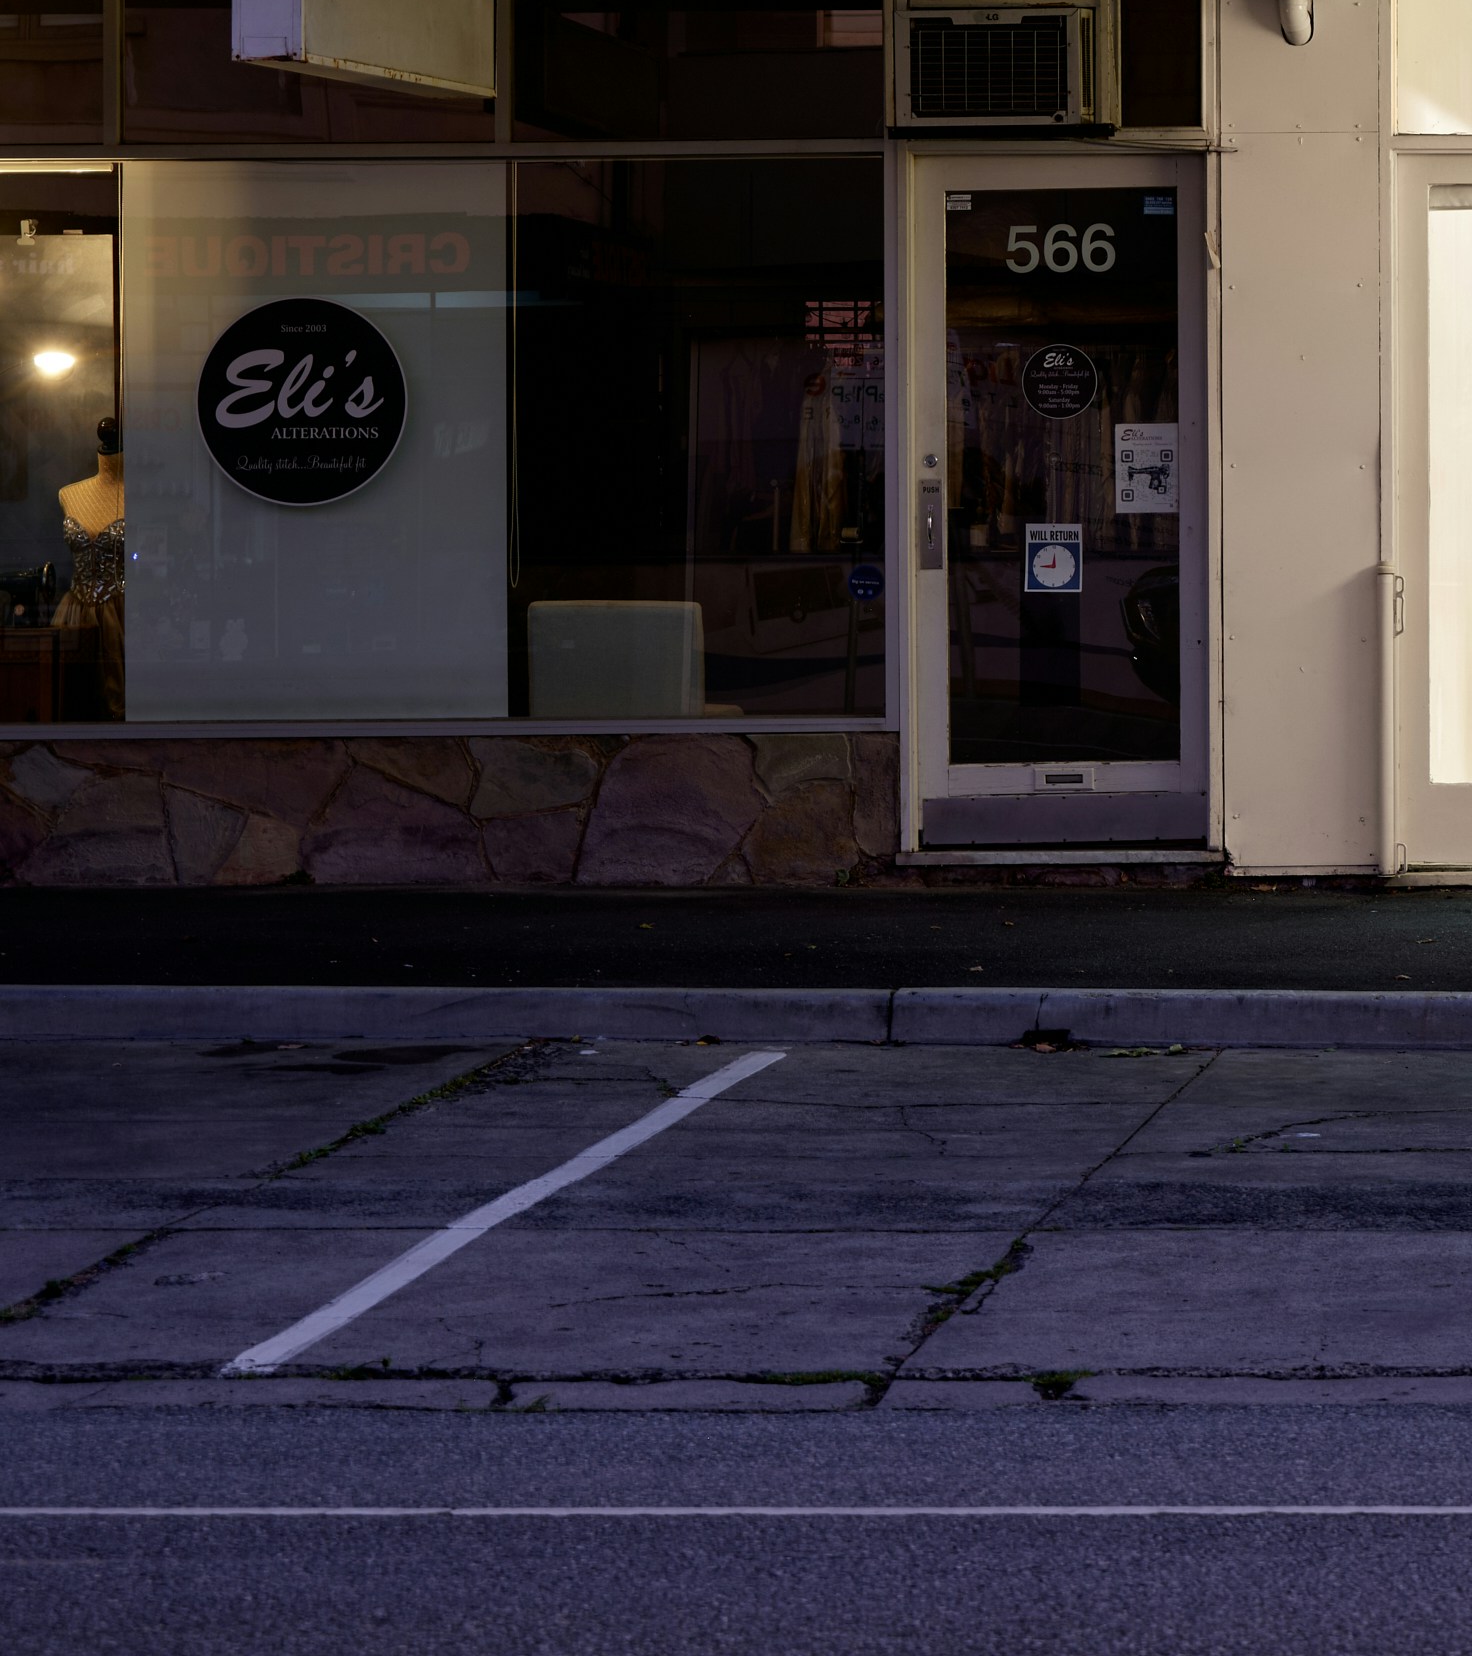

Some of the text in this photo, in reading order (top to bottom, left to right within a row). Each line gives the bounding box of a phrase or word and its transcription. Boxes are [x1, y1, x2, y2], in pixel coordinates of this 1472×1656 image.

[986, 13, 999, 21] LG
[1005, 222, 1117, 274] 566
[280, 324, 327, 333] Since 2003
[1043, 352, 1075, 368] Eli's
[215, 348, 385, 429] Eli's
[270, 426, 379, 439] ALTERATIONS
[236, 455, 273, 474] Quality
[355, 456, 366, 473] fit
[922, 486, 940, 494] PUSH
[1029, 530, 1079, 541] WILL RETURN
